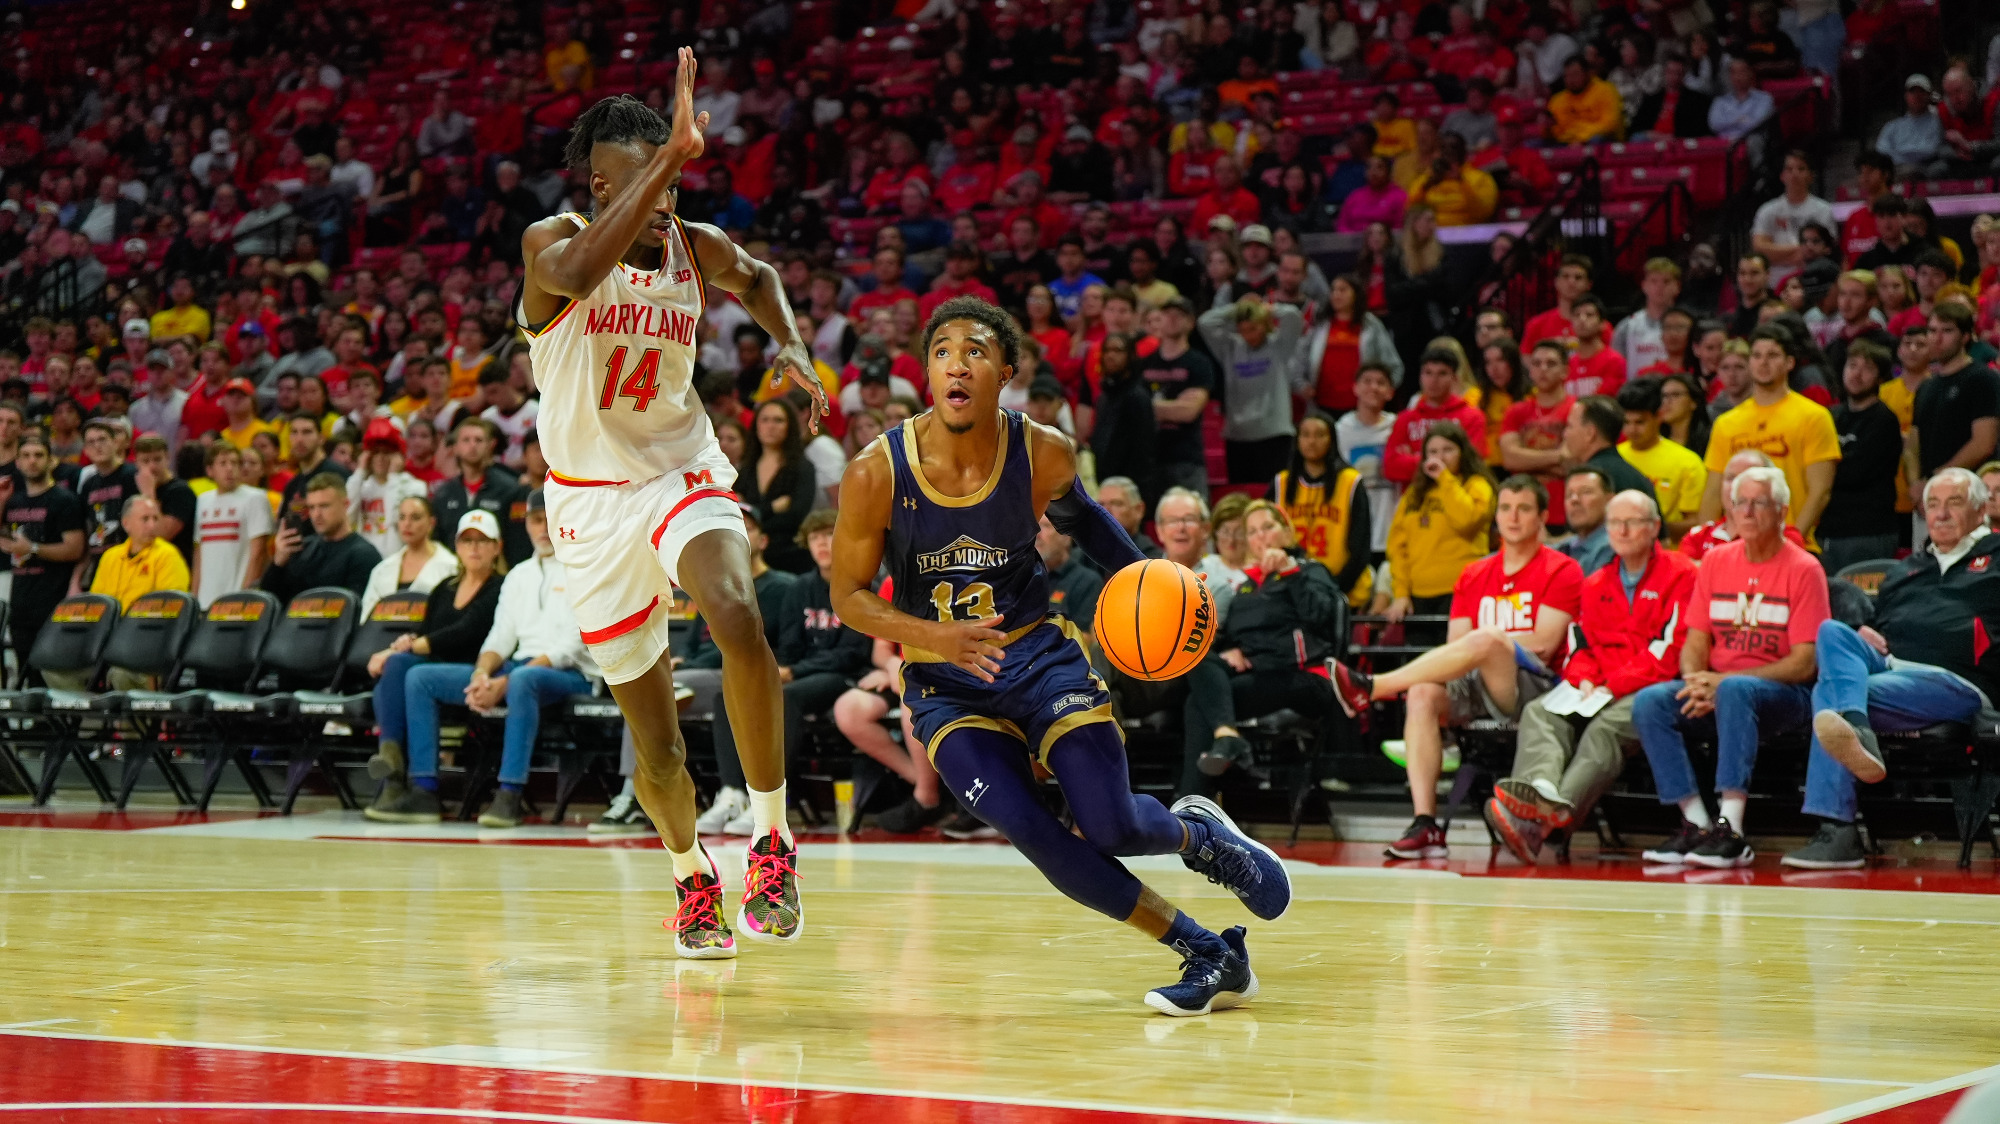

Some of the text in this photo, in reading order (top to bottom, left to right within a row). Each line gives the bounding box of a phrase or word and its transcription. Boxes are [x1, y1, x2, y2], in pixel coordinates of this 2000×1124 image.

[583, 303, 695, 346] MARYLAND
[599, 345, 662, 412] 14
[683, 469, 715, 491] M
[921, 548, 1004, 569] THE MOUNT
[930, 580, 998, 622] 13
[1181, 576, 1210, 653] Wilson
[1478, 591, 1534, 631] ONE
[1732, 591, 1765, 632] M
[1054, 696, 1093, 711] THE MOUNT
